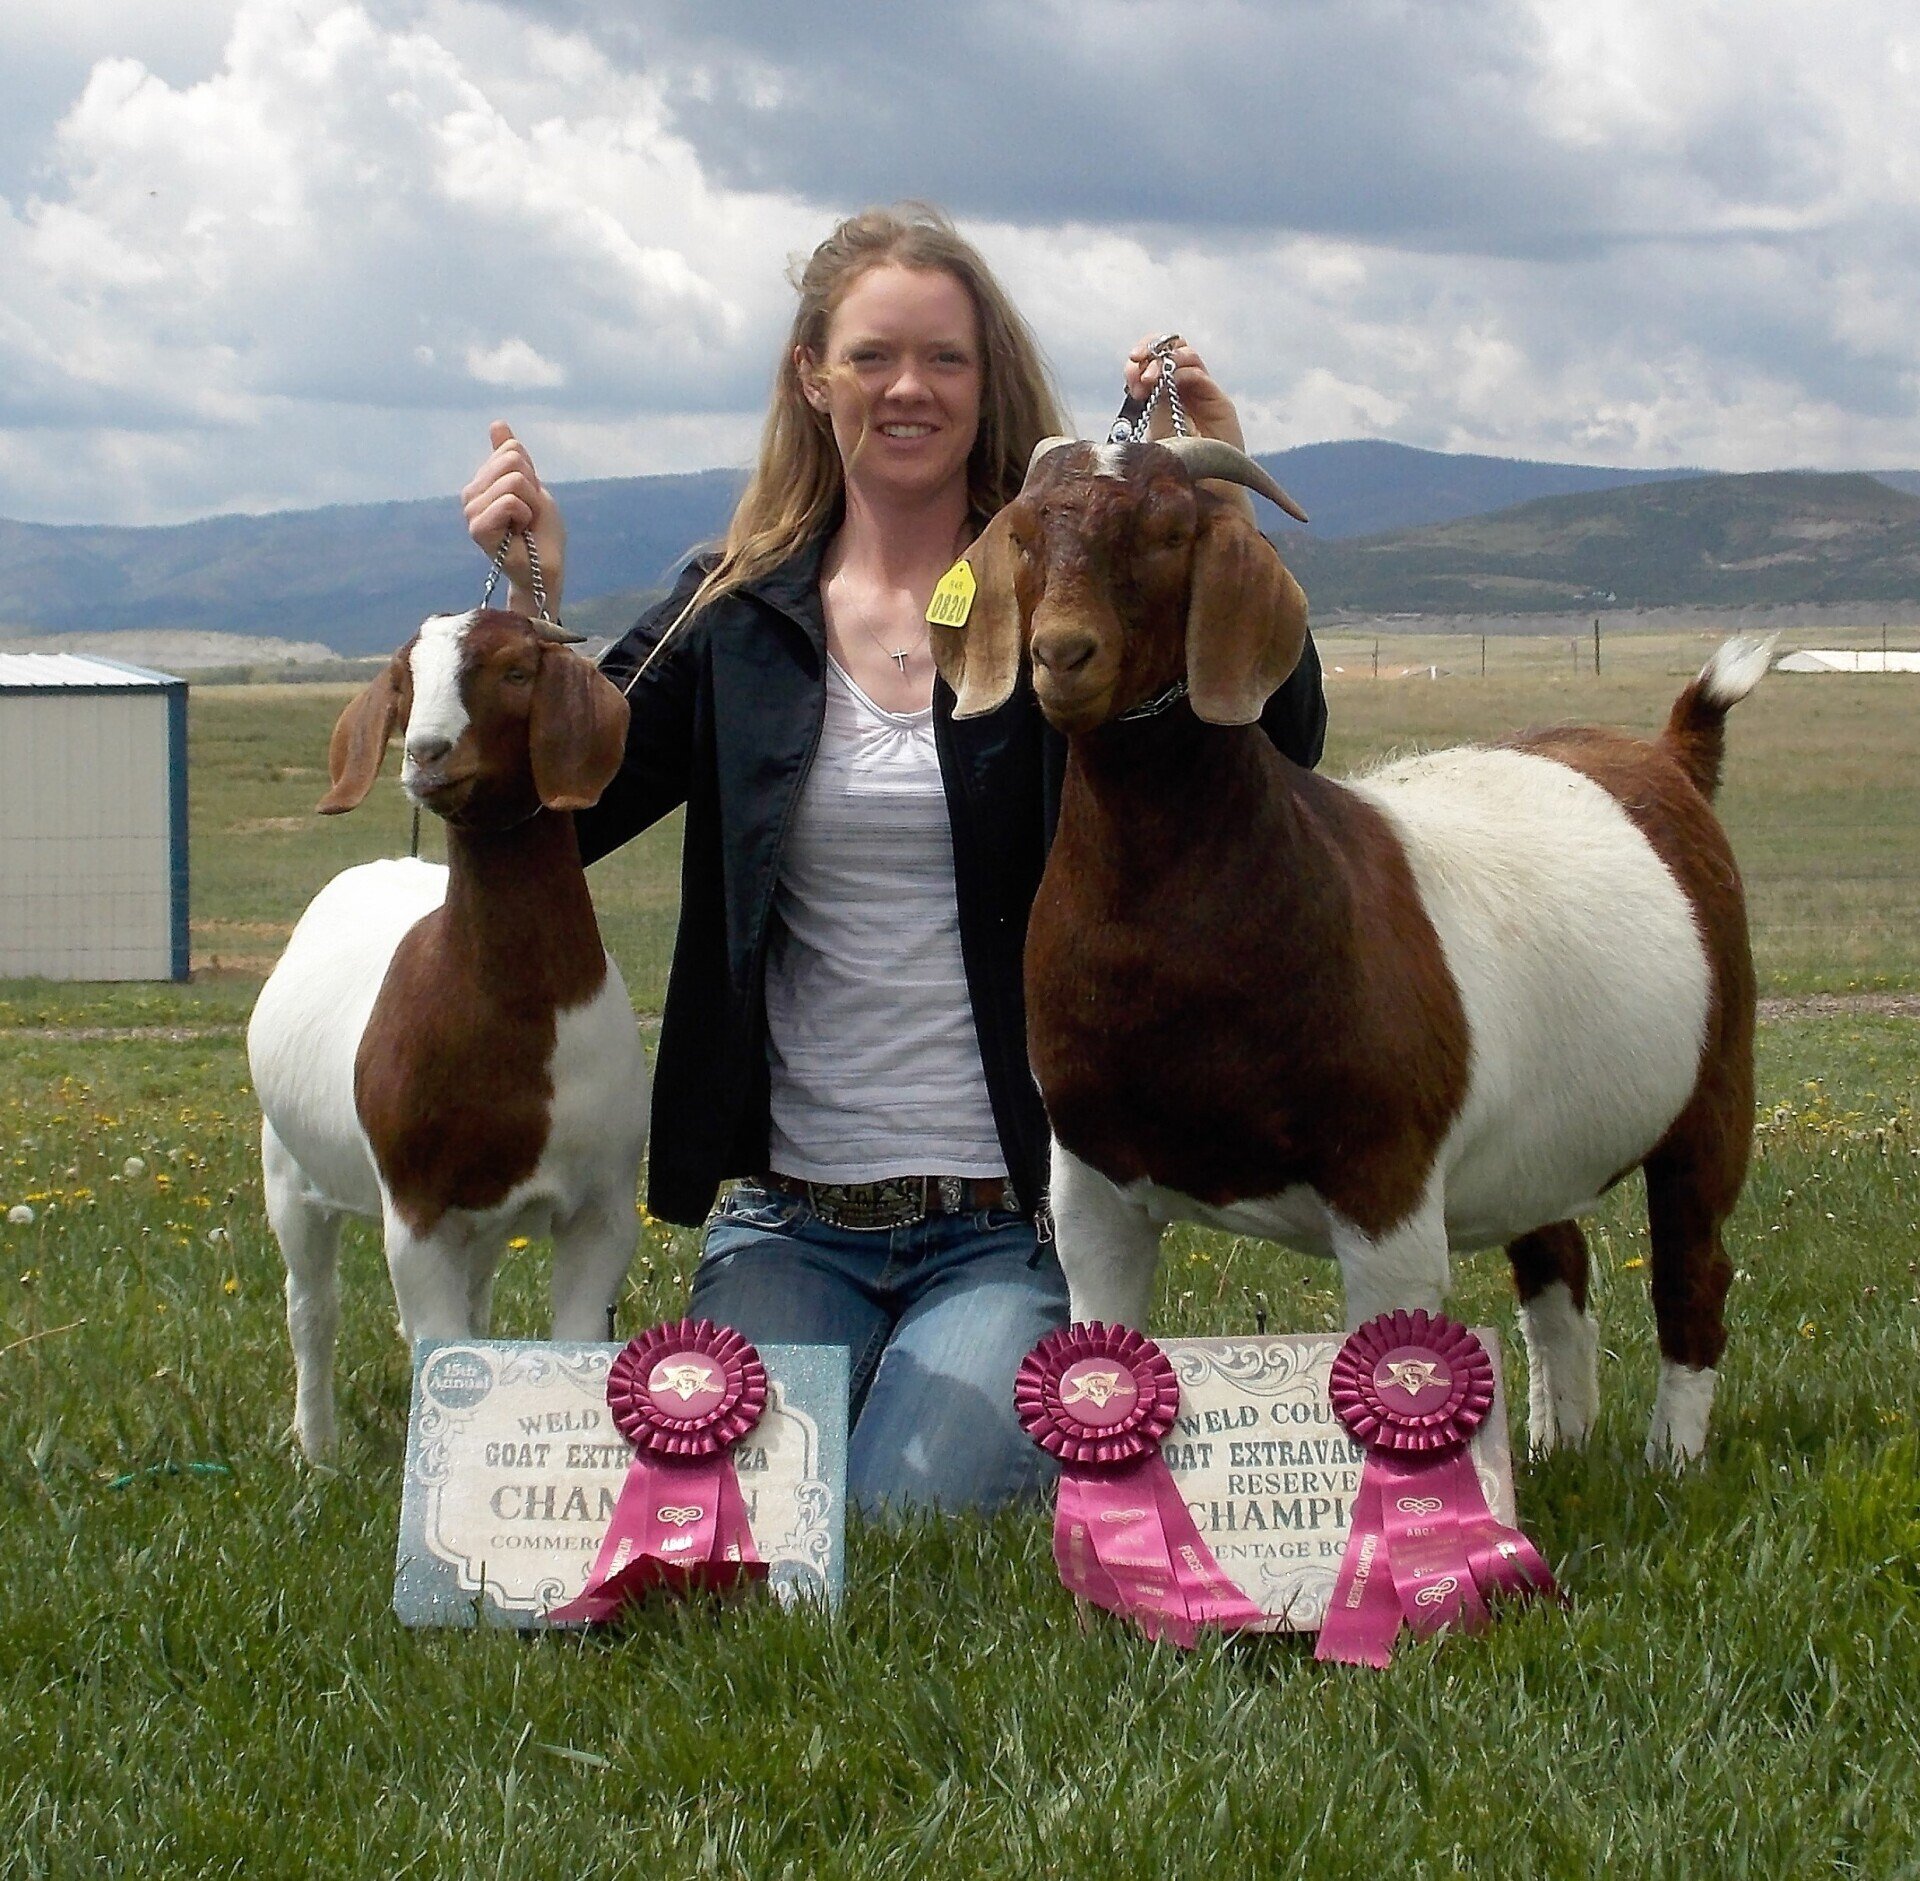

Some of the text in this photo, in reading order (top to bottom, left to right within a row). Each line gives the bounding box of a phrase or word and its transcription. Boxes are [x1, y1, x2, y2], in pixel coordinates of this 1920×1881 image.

[931, 593, 967, 622] 0820
[517, 1409, 600, 1436] WELD
[1177, 1403, 1331, 1437] WELD COU
[485, 1441, 550, 1467] GOAT
[1165, 1438, 1363, 1471] OAT EXTRAVAG
[1228, 1470, 1357, 1496] RESERVE
[1187, 1497, 1352, 1532] CHAMPI
[1213, 1541, 1310, 1560] ENTAGE
